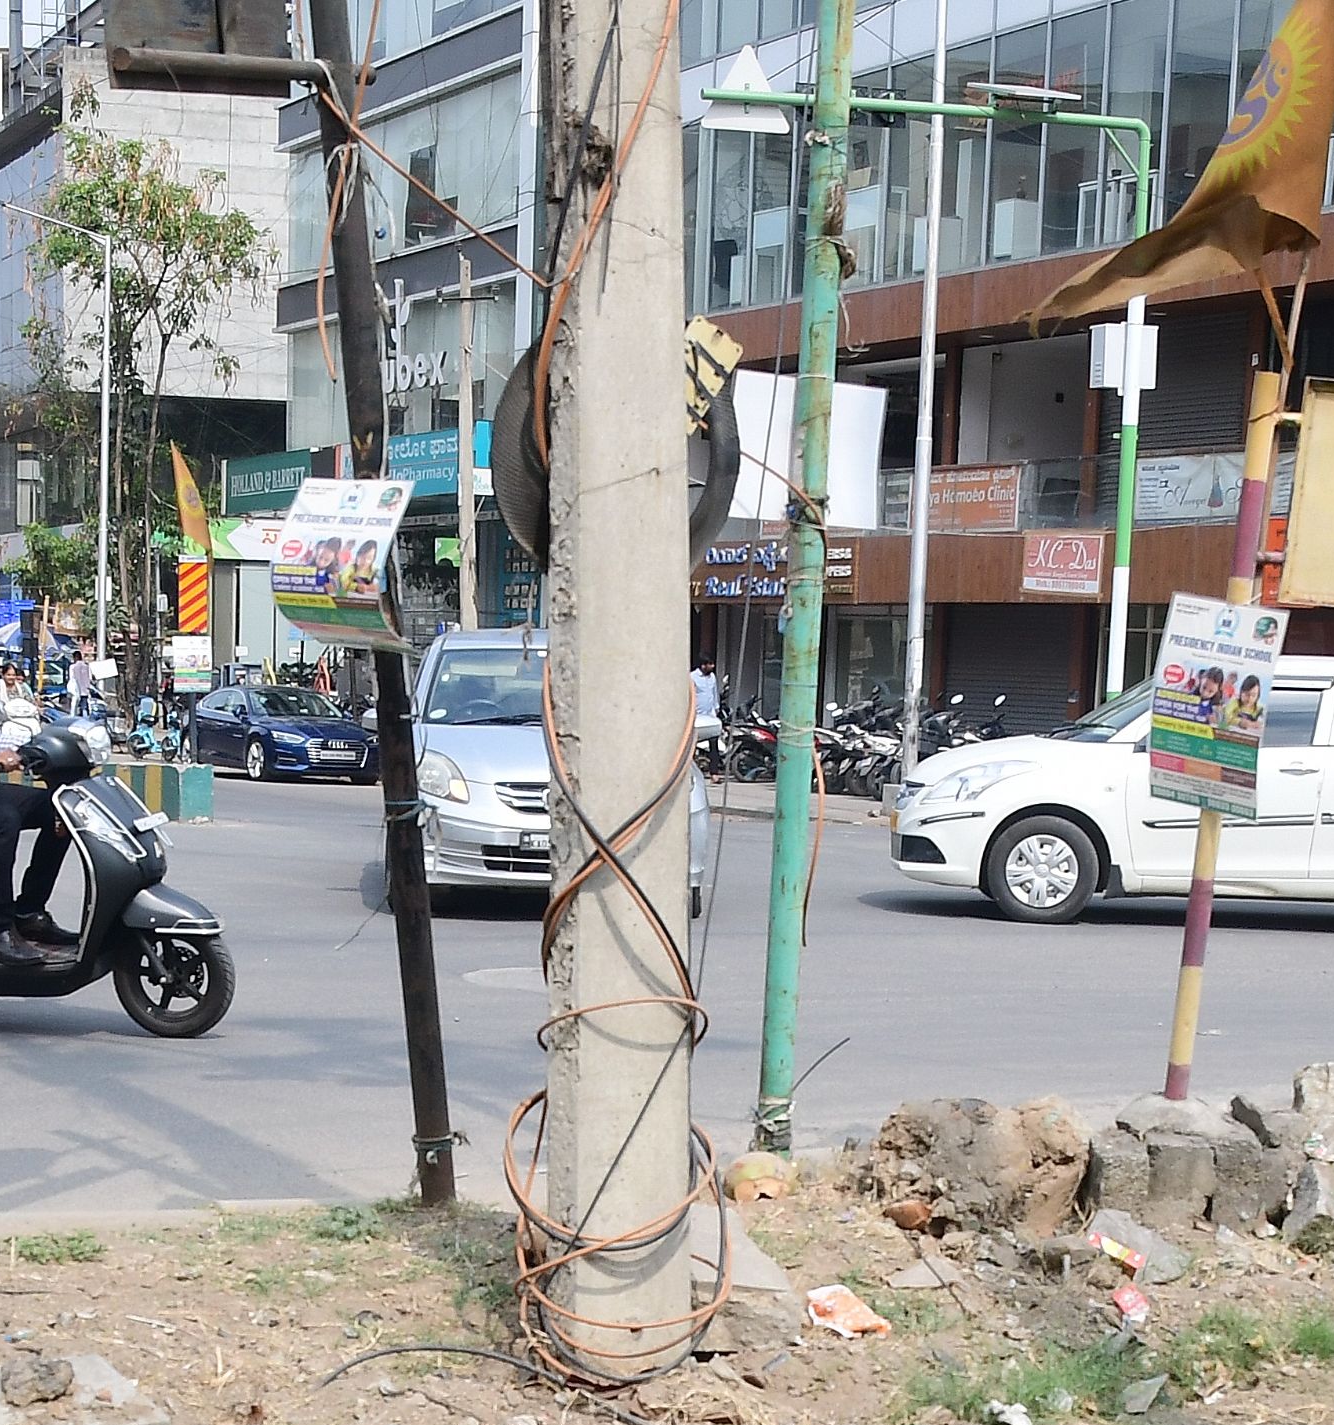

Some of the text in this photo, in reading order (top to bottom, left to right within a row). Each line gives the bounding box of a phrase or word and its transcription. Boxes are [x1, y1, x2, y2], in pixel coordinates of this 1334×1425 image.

[231, 471, 263, 497] HOLLAND
[272, 466, 305, 489] BARRETT
[987, 484, 1015, 501] Clinic
[1068, 540, 1096, 570] Das
[705, 573, 746, 597] Real
[1168, 633, 1216, 652] PRESIDENCY
[1243, 646, 1272, 663] SCHOOL
